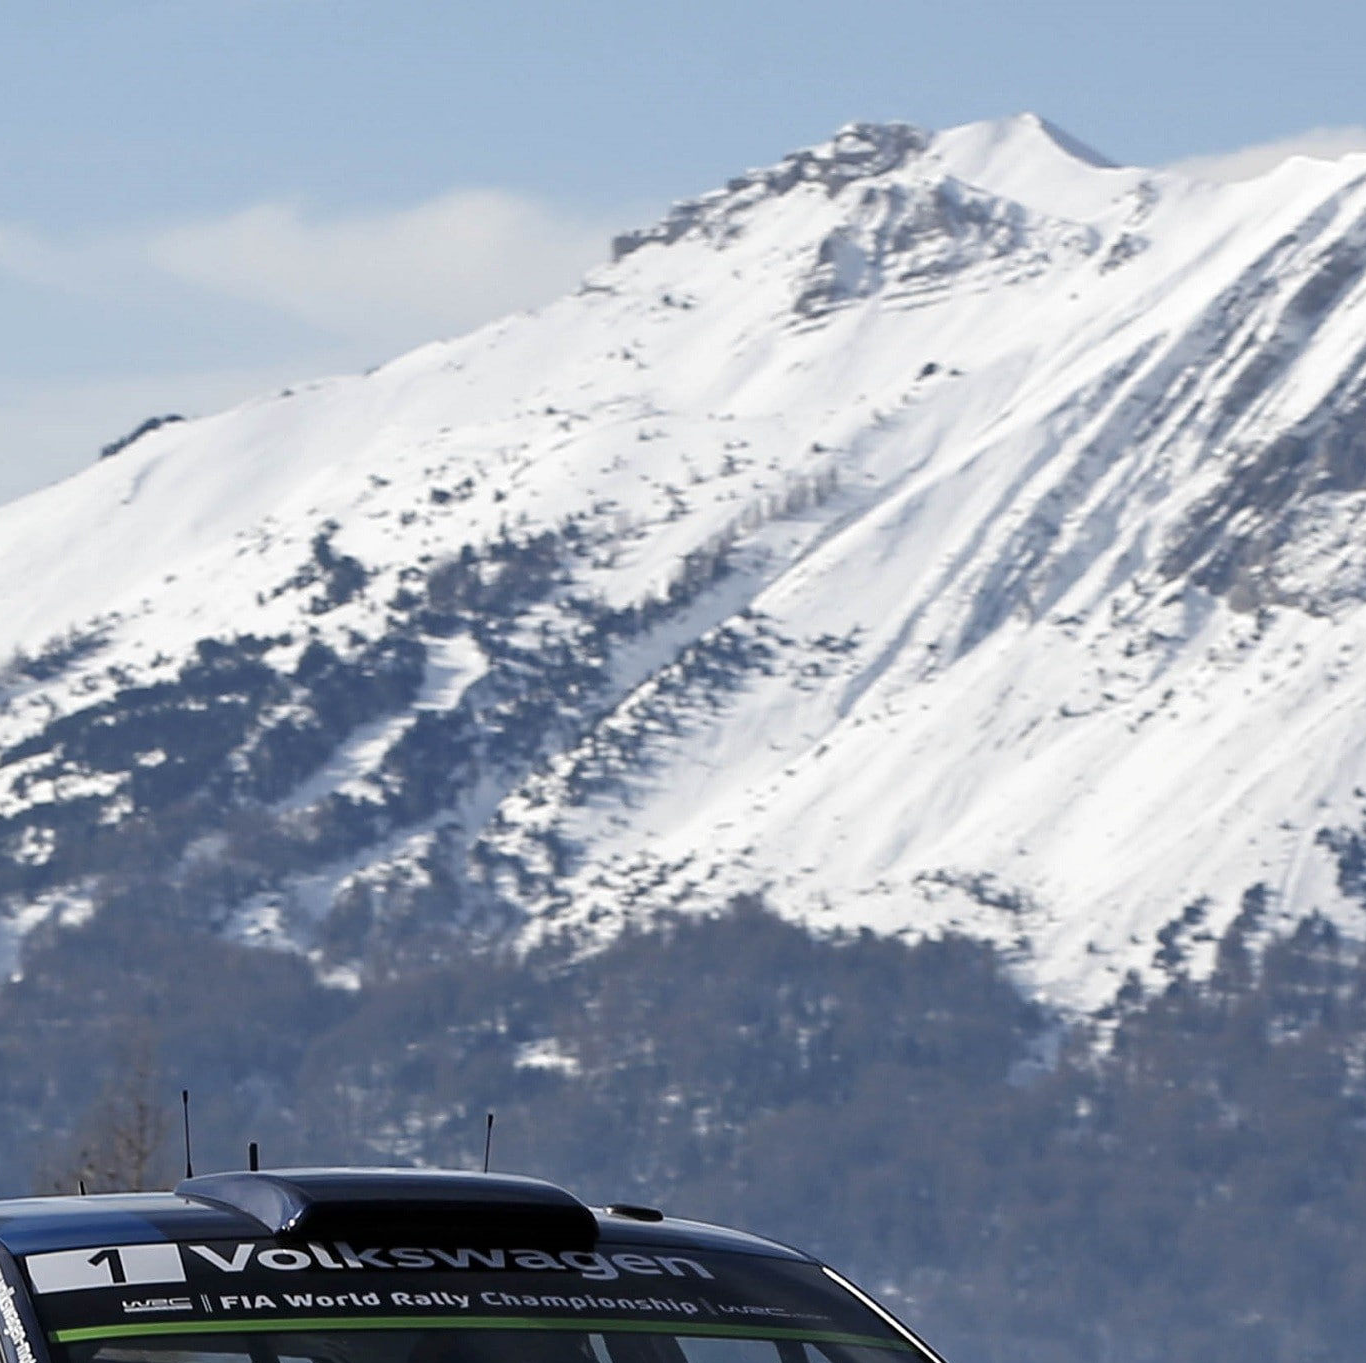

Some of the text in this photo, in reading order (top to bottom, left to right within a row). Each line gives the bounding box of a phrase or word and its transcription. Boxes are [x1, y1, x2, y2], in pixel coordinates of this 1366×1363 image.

[87, 1247, 128, 1285] 1
[188, 1243, 715, 1281] Volkswagen
[219, 1295, 277, 1310] FIA
[282, 1292, 381, 1308] World
[390, 1291, 469, 1309] Rally
[480, 1291, 699, 1315] Championship
